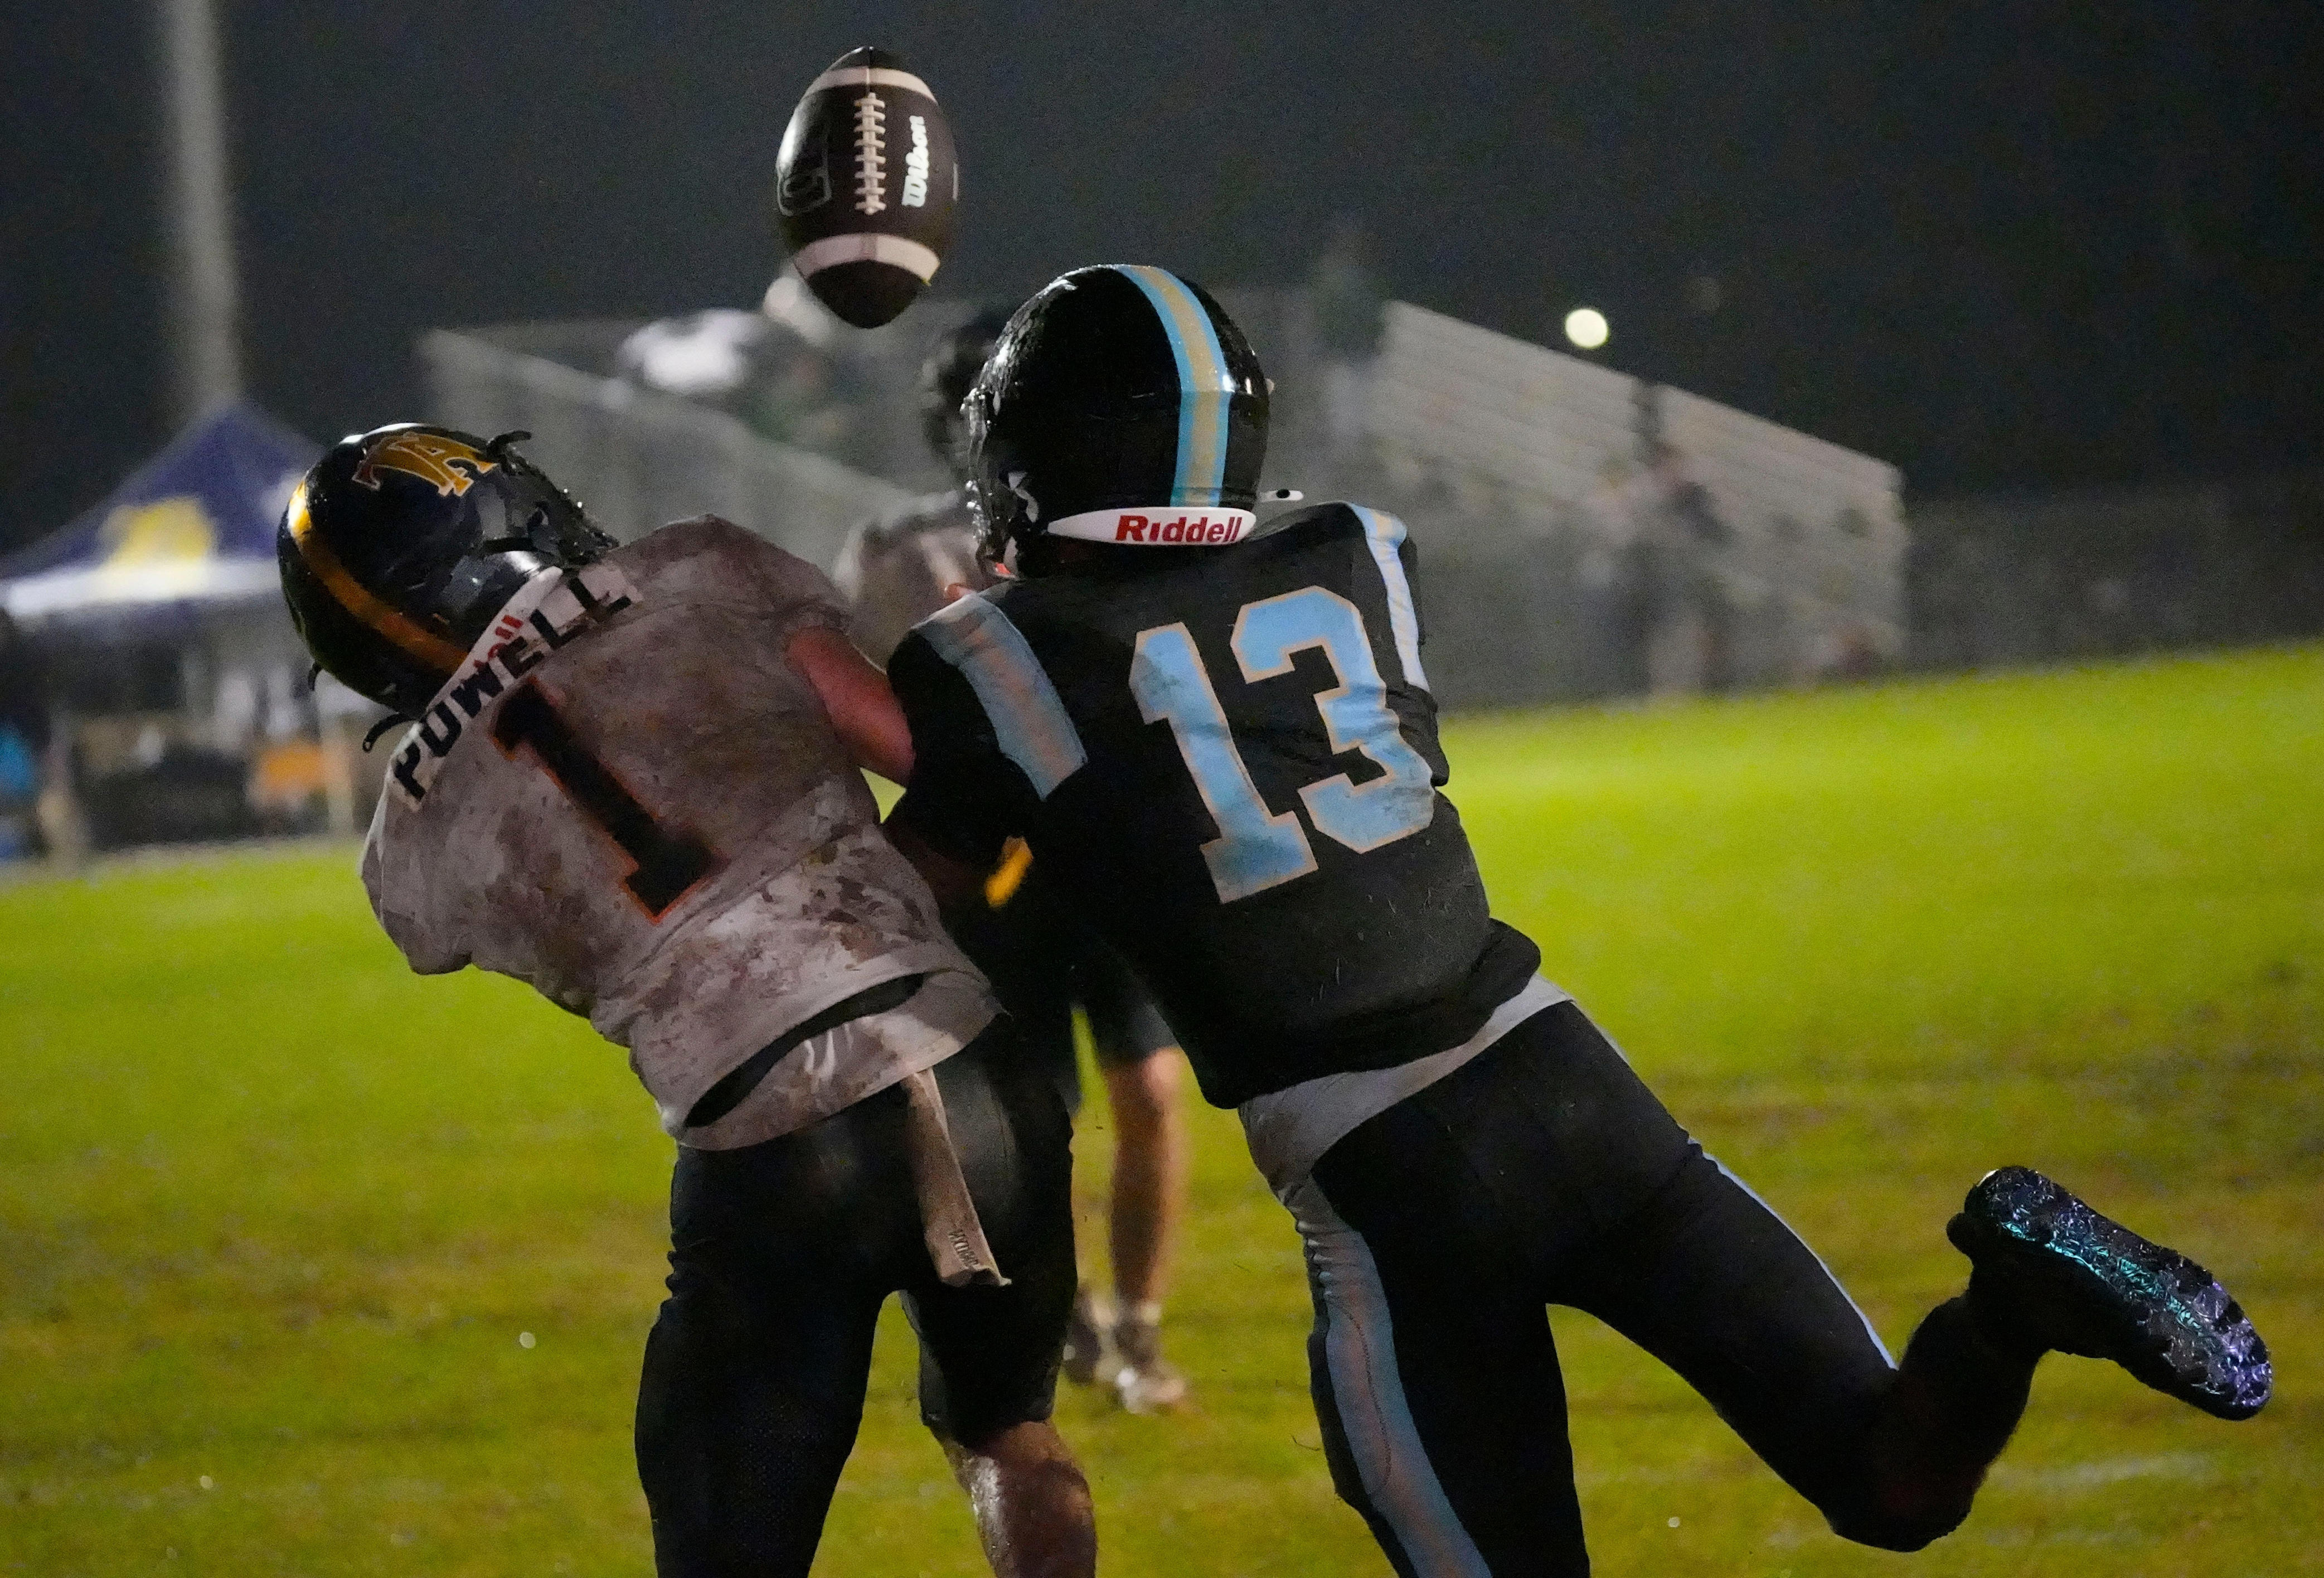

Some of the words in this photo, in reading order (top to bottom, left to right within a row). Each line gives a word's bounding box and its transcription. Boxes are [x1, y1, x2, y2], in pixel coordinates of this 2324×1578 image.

[901, 115, 930, 207] Wilson
[1115, 514, 1243, 543] Riddell
[392, 576, 632, 801] POWELL
[489, 674, 729, 926] 1
[1128, 585, 1435, 904] 13
